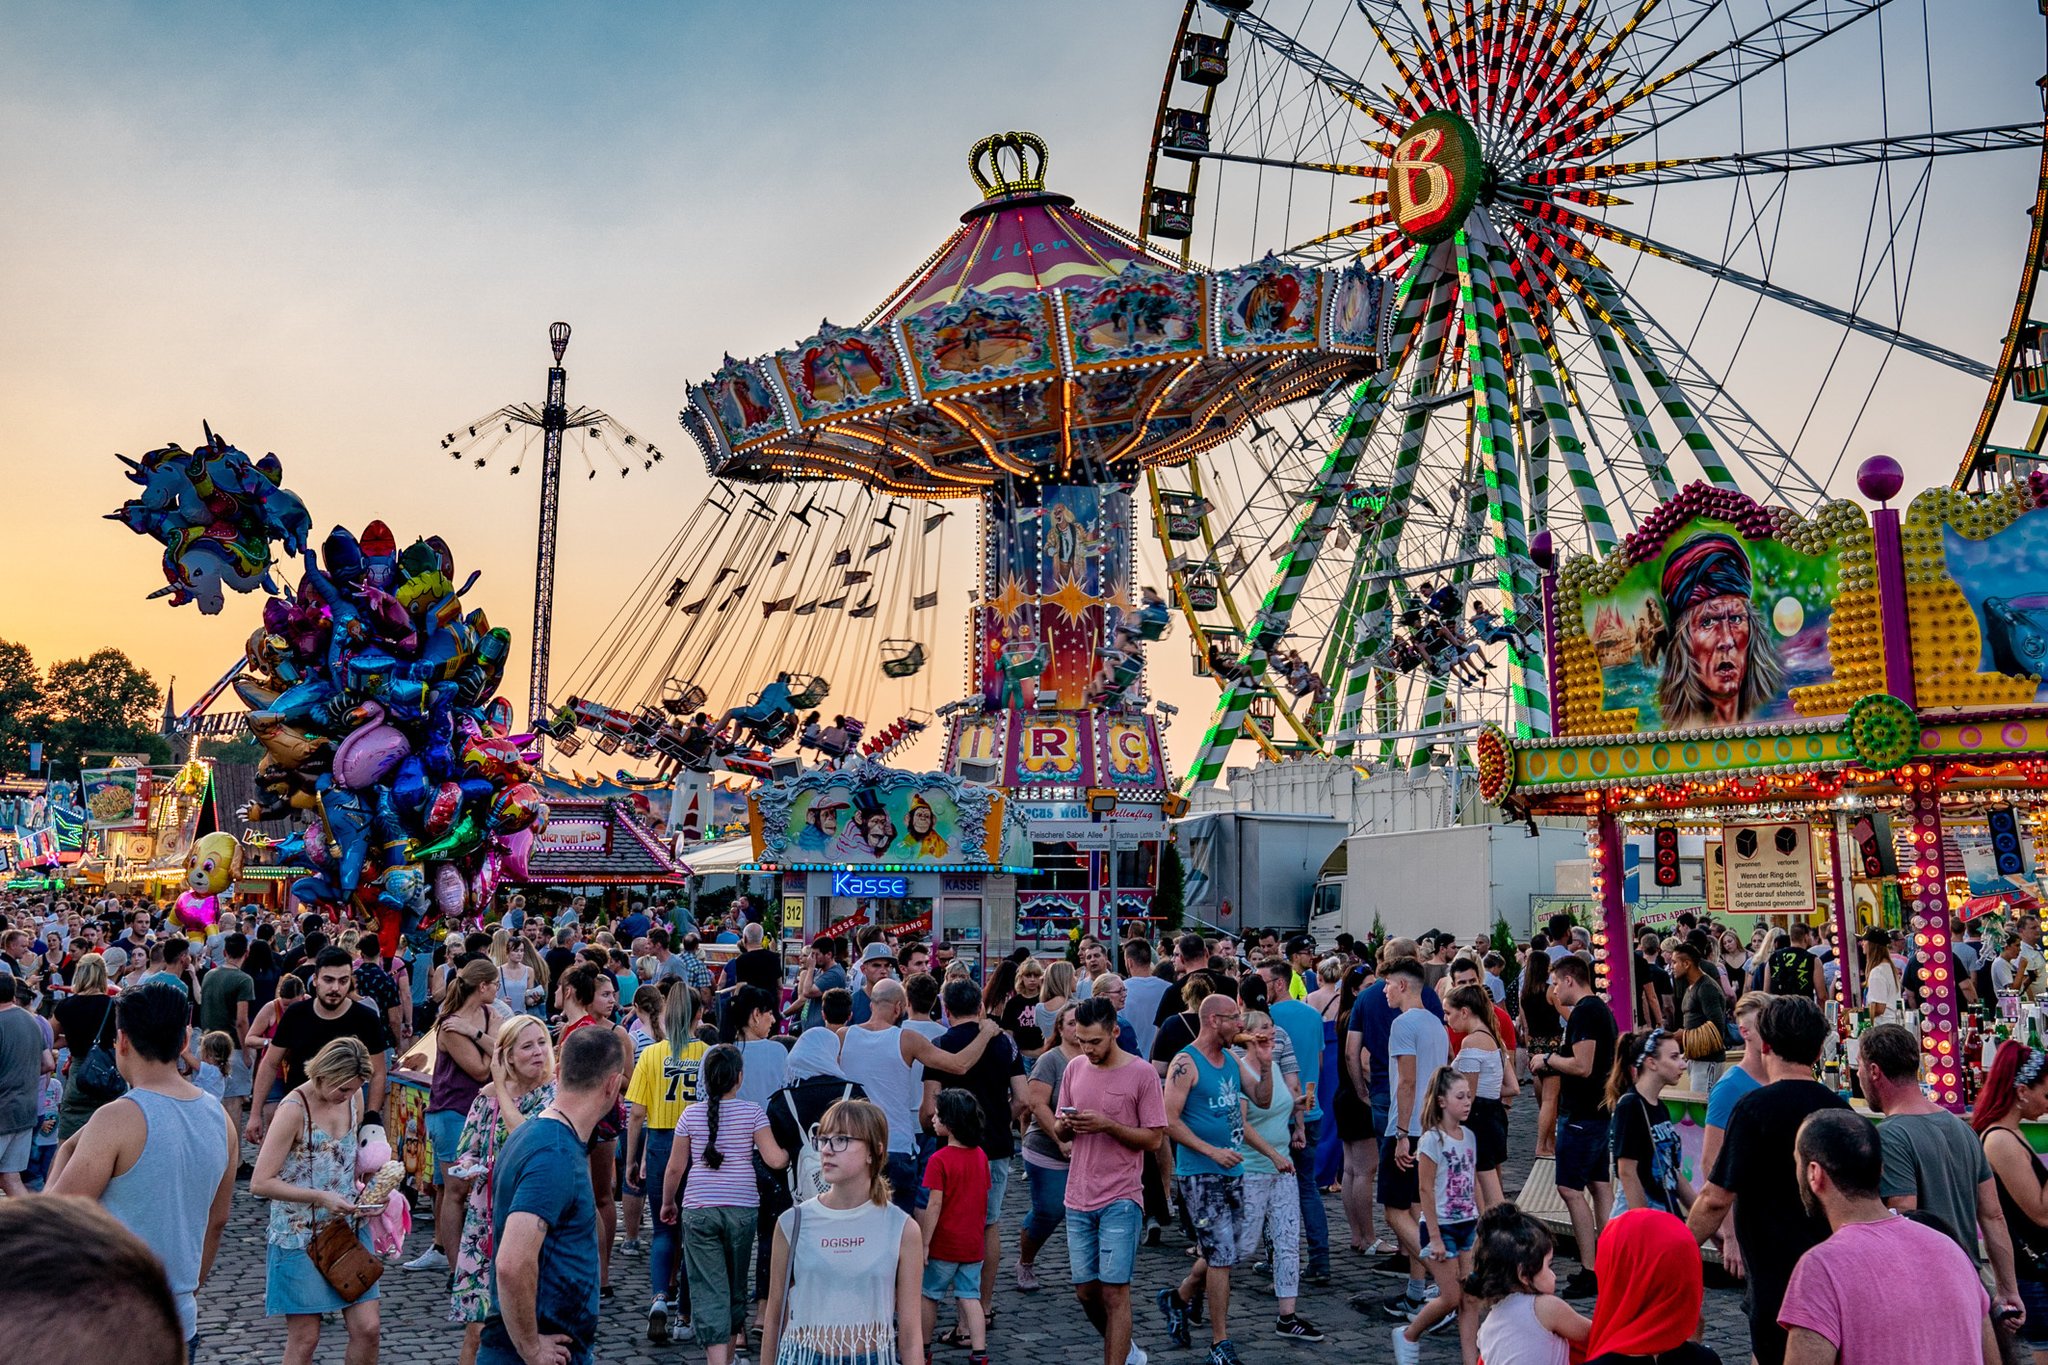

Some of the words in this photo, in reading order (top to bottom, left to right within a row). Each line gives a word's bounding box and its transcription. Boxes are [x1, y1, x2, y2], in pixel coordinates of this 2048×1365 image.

[1393, 128, 1456, 231] B
[1106, 808, 1153, 821] Wellenflug
[561, 834, 579, 844] vom
[581, 830, 601, 843] Fass
[1030, 831, 1064, 839] Fleischerei
[1066, 831, 1085, 839] Sabel
[1087, 831, 1104, 839] Allee
[1734, 861, 1761, 869] gewonnen
[1770, 871, 1784, 880] Ring
[834, 873, 905, 895] Kasse
[944, 878, 981, 891] KASSE
[1736, 881, 1765, 889] Untersatz
[1754, 890, 1775, 898] darauf
[1735, 900, 1771, 909] Gegenstand
[1772, 899, 1806, 908] gewonnen!
[786, 905, 801, 921] 312
[825, 918, 855, 937] KASSE
[888, 920, 922, 936] NGANG
[664, 1056, 701, 1069] Oiginal
[664, 1067, 702, 1102] 79
[821, 1236, 865, 1249] DGISHP
